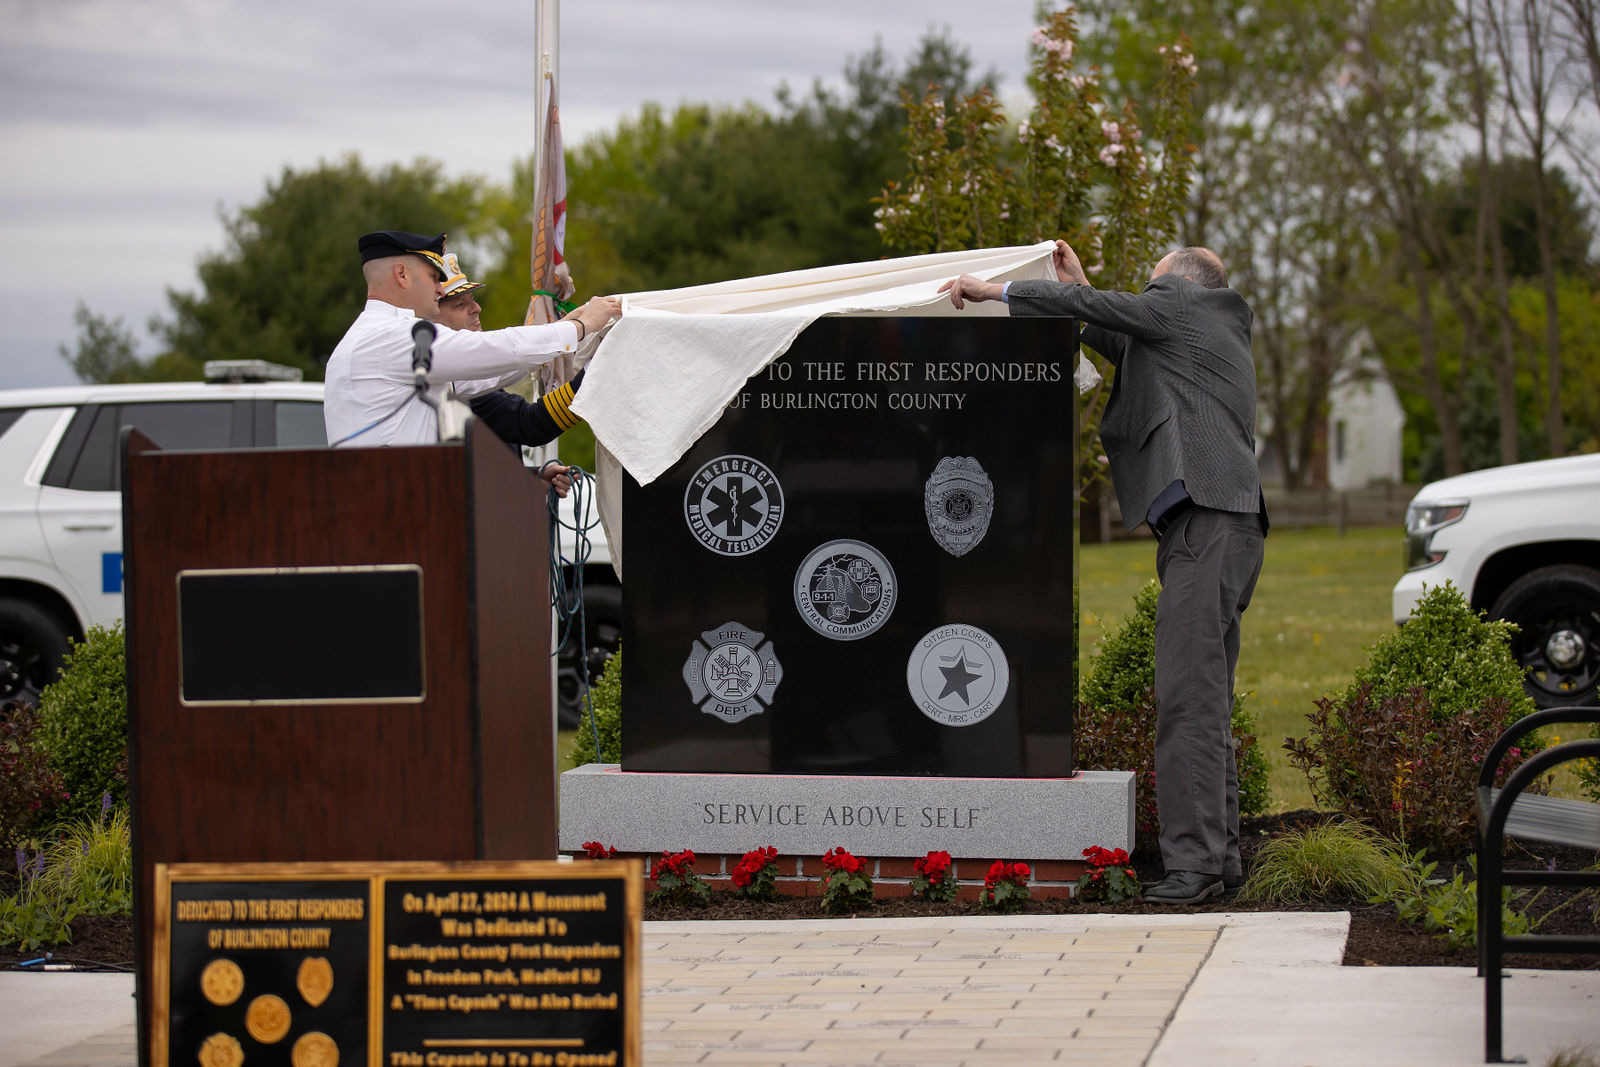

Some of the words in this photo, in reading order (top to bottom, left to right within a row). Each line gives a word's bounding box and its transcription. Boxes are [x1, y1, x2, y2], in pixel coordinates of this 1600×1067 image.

[767, 362, 793, 381] TO
[803, 362, 846, 381] THE
[857, 362, 914, 382] FIRST
[924, 362, 1062, 382] RESPONDERS
[729, 393, 751, 409] OF
[760, 393, 878, 410] BURLINGTON
[888, 393, 967, 410] COUNTY
[695, 459, 775, 488] EMERGENCY
[689, 504, 722, 550] MEDICAL
[726, 505, 781, 553] TECHNICIAN
[814, 593, 834, 601] 9-1-1
[800, 591, 824, 627] CENTRAL
[826, 588, 892, 634] COMMUNICATIONS
[718, 630, 748, 640] FIRE
[923, 628, 958, 648] CITIZEN
[961, 628, 993, 649] CORPS
[714, 703, 752, 716] DEPT.
[921, 700, 943, 718] CERT
[947, 714, 968, 723] MRC
[973, 700, 994, 718] CART
[822, 805, 907, 827] ABOVE
[177, 901, 232, 921] DEDICATED
[233, 900, 248, 921] TO
[249, 900, 268, 921] THE
[268, 899, 298, 921] FIRST
[300, 898, 364, 920] RESPONDERS
[402, 892, 424, 913] On
[425, 892, 459, 916] April
[460, 891, 482, 914] 27,
[483, 891, 517, 912] 2024
[518, 891, 531, 912] A
[532, 891, 607, 912] Monument
[441, 918, 473, 937] Was
[474, 917, 546, 937] Dedicated
[547, 917, 567, 937] To
[208, 928, 223, 949] OF
[223, 928, 289, 949] BURLINGTON
[289, 927, 331, 949] COUNTY
[388, 943, 459, 963] Burlington
[460, 943, 508, 963] County
[509, 943, 541, 959] First
[542, 941, 620, 963] Responders
[406, 970, 422, 985] In
[423, 968, 482, 985] Freedom
[483, 968, 520, 986] Park,
[520, 967, 580, 985] Medford
[581, 968, 601, 985] NJ
[390, 994, 404, 1010] A
[405, 994, 447, 1010] "Time
[448, 993, 507, 1013] Capsule"
[508, 994, 539, 1010] Was
[540, 993, 571, 1010] Also
[572, 992, 619, 1010] Buried
[389, 1052, 424, 1067] This
[425, 1052, 489, 1067] Capsule
[489, 1052, 506, 1067] Is
[507, 1052, 529, 1067] To
[530, 1052, 554, 1067] Be
[554, 1050, 619, 1067] Opened
